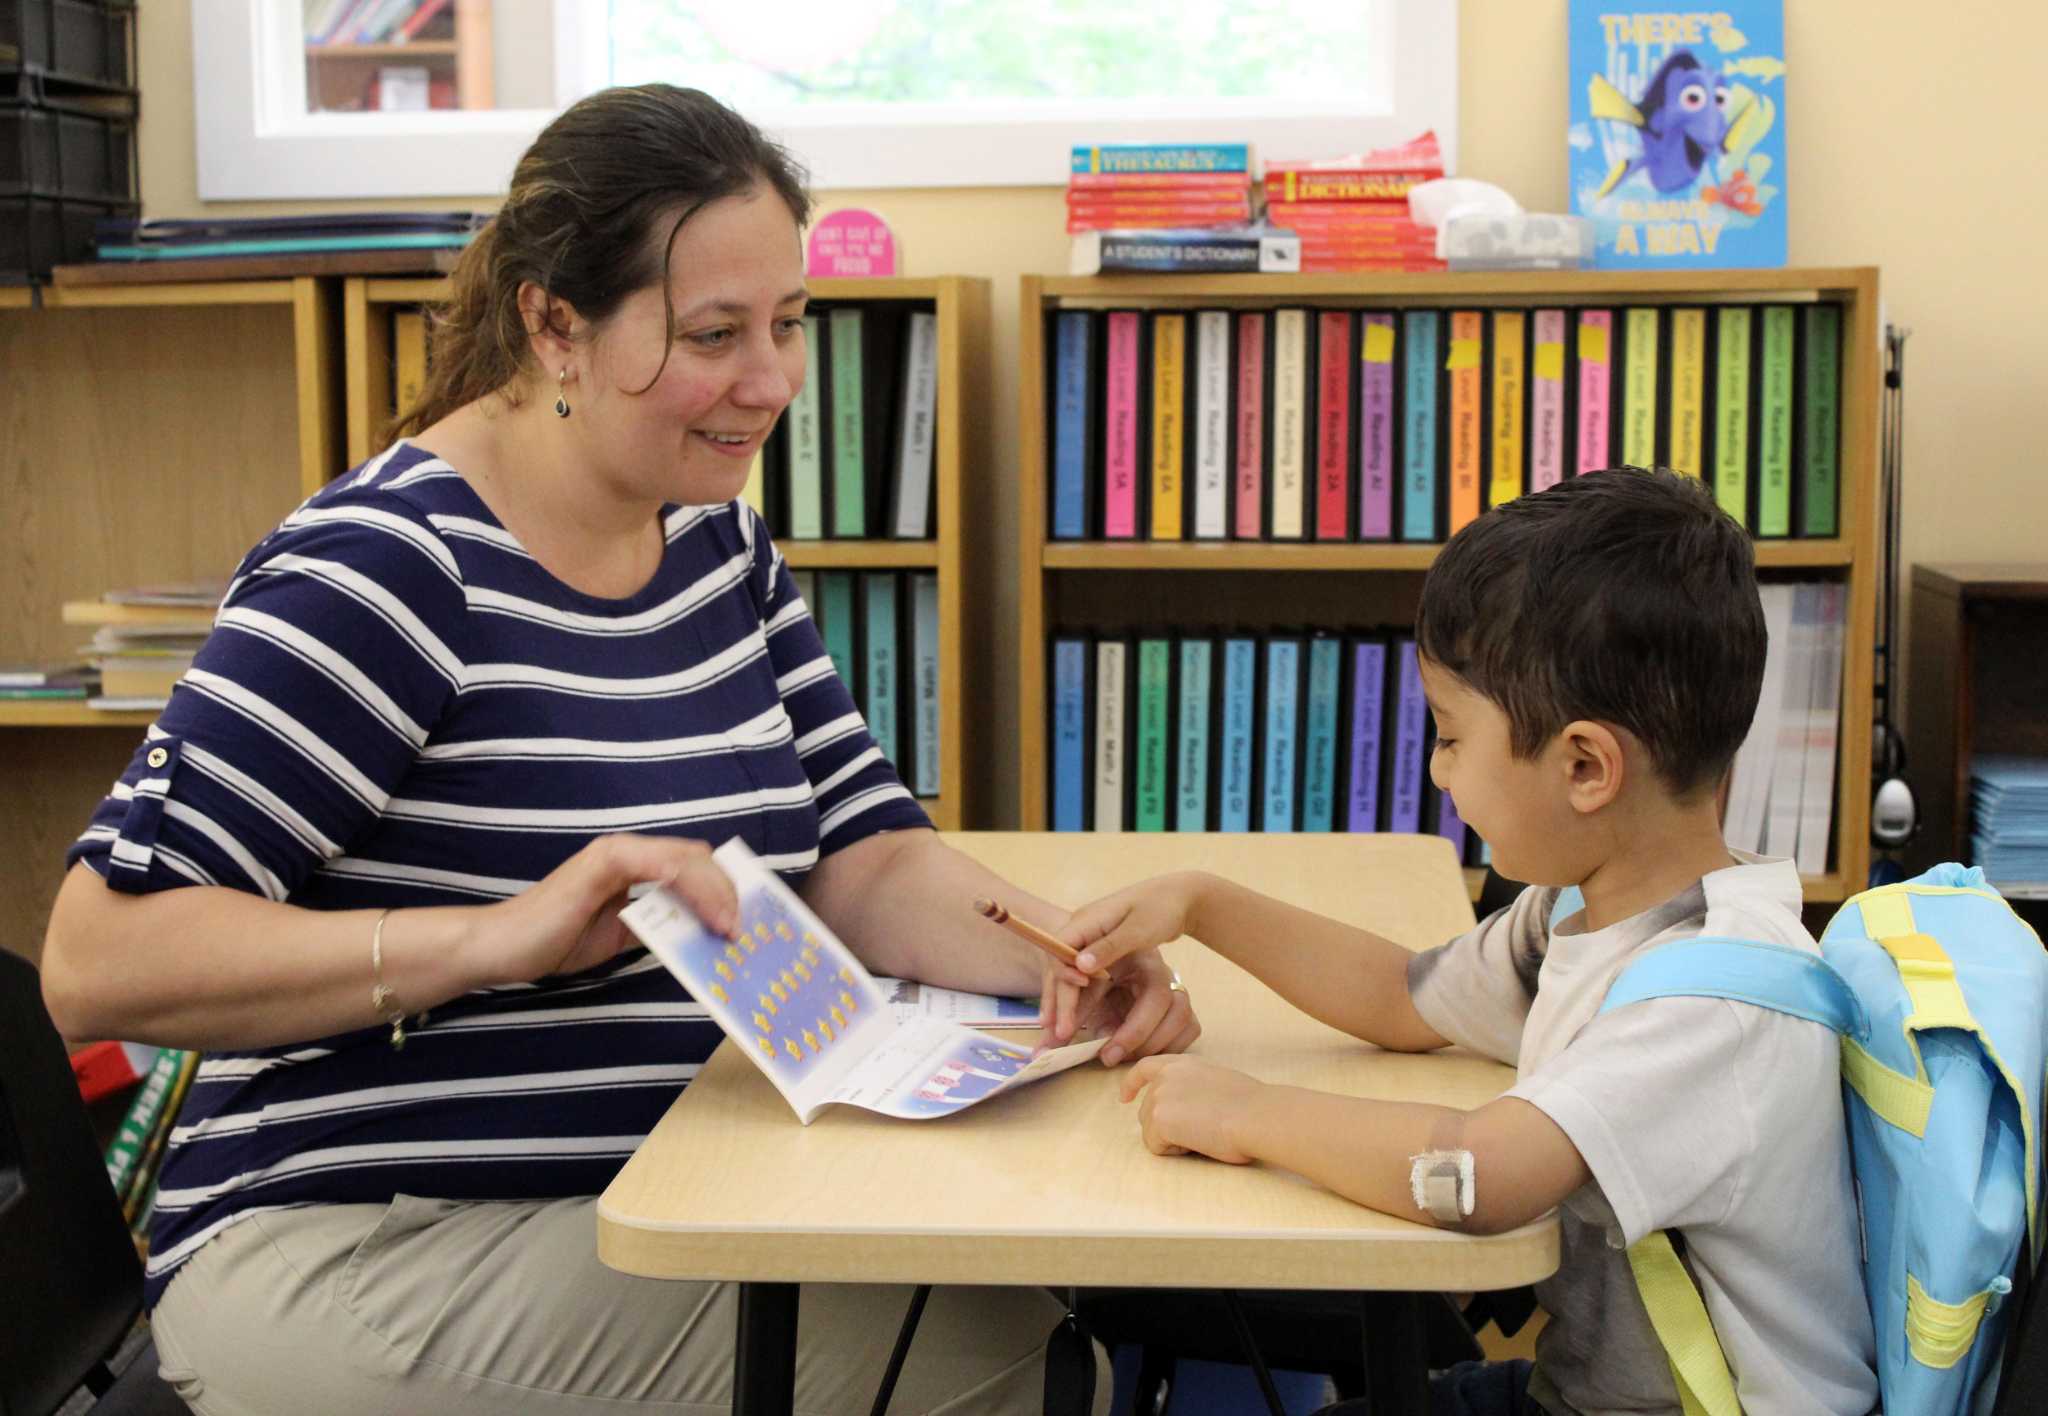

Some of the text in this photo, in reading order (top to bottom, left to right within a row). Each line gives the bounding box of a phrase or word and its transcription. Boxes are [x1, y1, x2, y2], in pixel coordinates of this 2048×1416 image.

[1104, 245, 1114, 258] A
[1184, 246, 1259, 261] DICTIONARY
[1113, 410, 1128, 468] Reading
[1159, 414, 1174, 470] Reading
[1205, 410, 1219, 467] Reading
[1282, 408, 1295, 467] Reading
[1325, 411, 1341, 469] Reading
[1370, 413, 1383, 471] Reading
[1458, 411, 1472, 470] Reading
[1725, 408, 1740, 467] Reading
[1769, 406, 1783, 465] Reading
[1144, 736, 1159, 794] Reading
[1183, 738, 1199, 795] Reading
[1229, 736, 1245, 794] Reading
[1271, 738, 1287, 796] Reading
[1311, 735, 1328, 794] Reading
[1357, 740, 1375, 798] Reading
[1399, 738, 1417, 796] Reading
